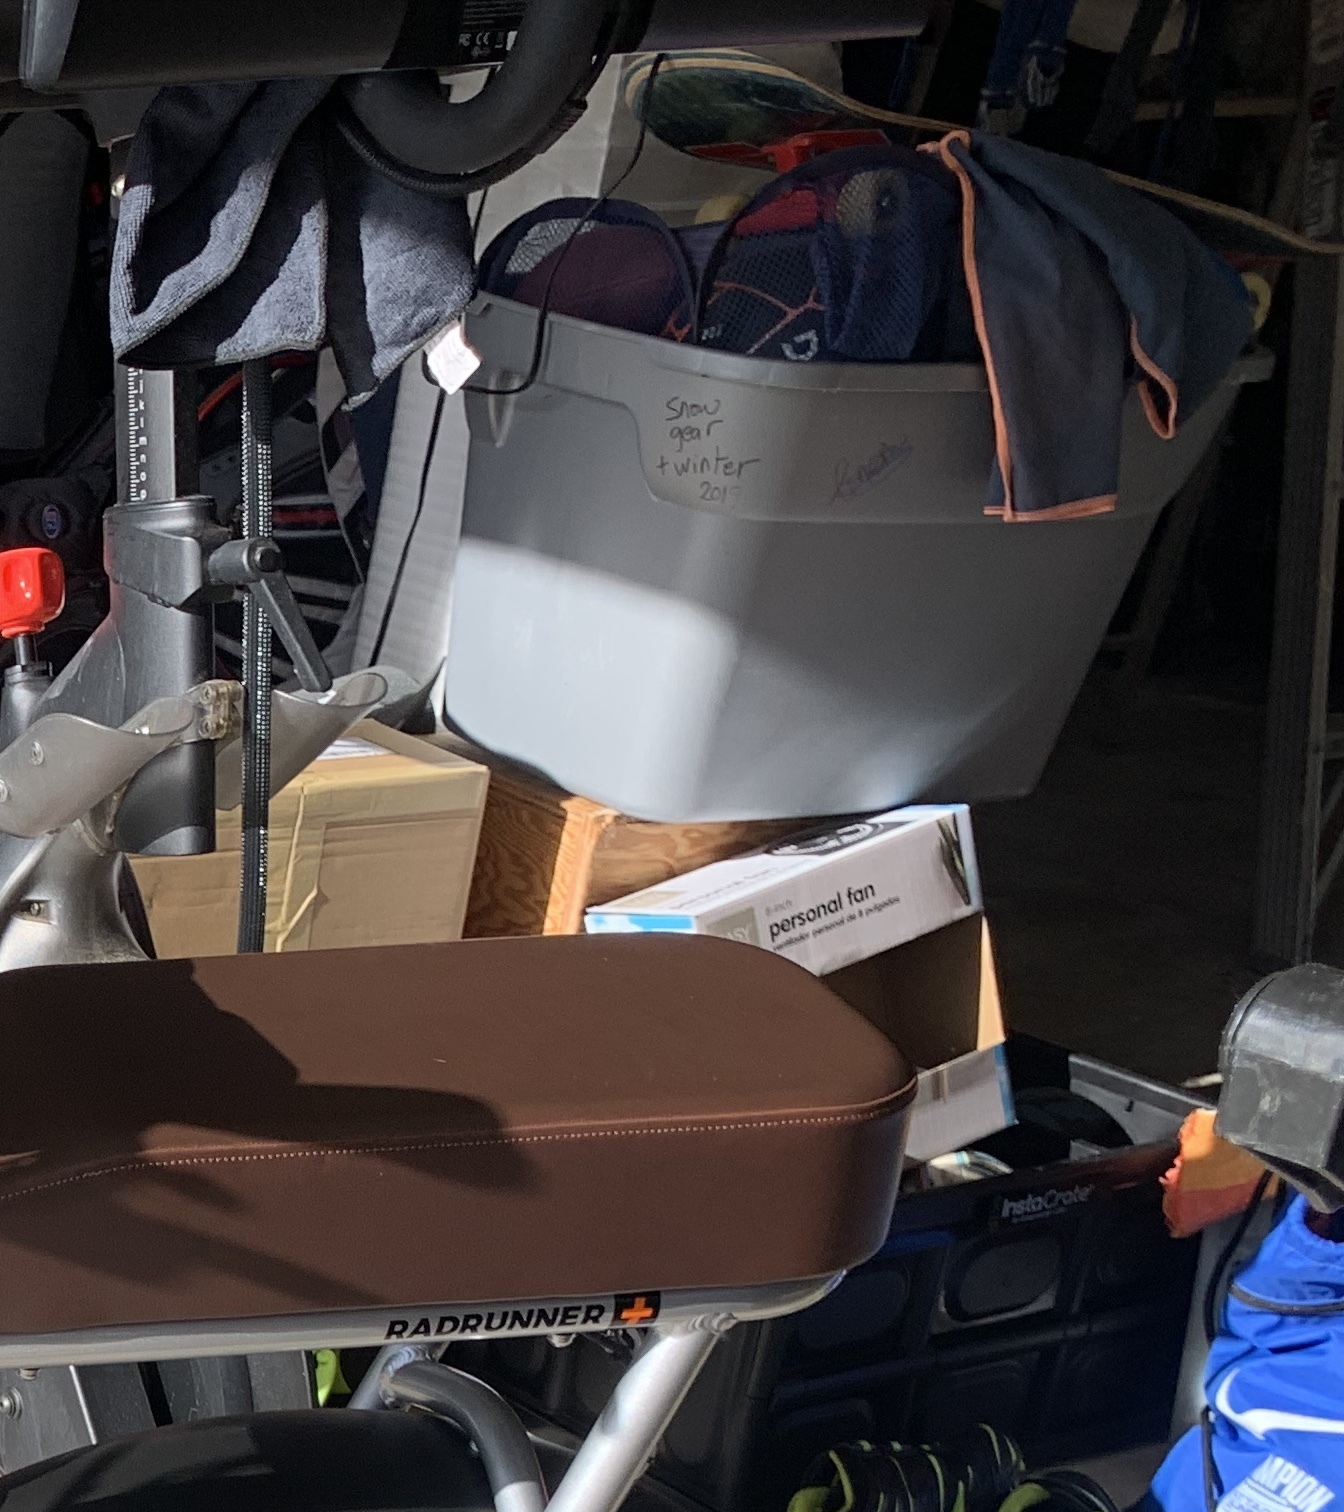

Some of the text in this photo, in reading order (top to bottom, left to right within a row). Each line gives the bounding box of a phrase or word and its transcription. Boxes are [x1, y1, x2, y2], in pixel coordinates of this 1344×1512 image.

[669, 420, 724, 452] gear
[769, 892, 844, 943] personal
[846, 883, 876, 906] fan
[384, 1304, 606, 1340] RADRUNNER
